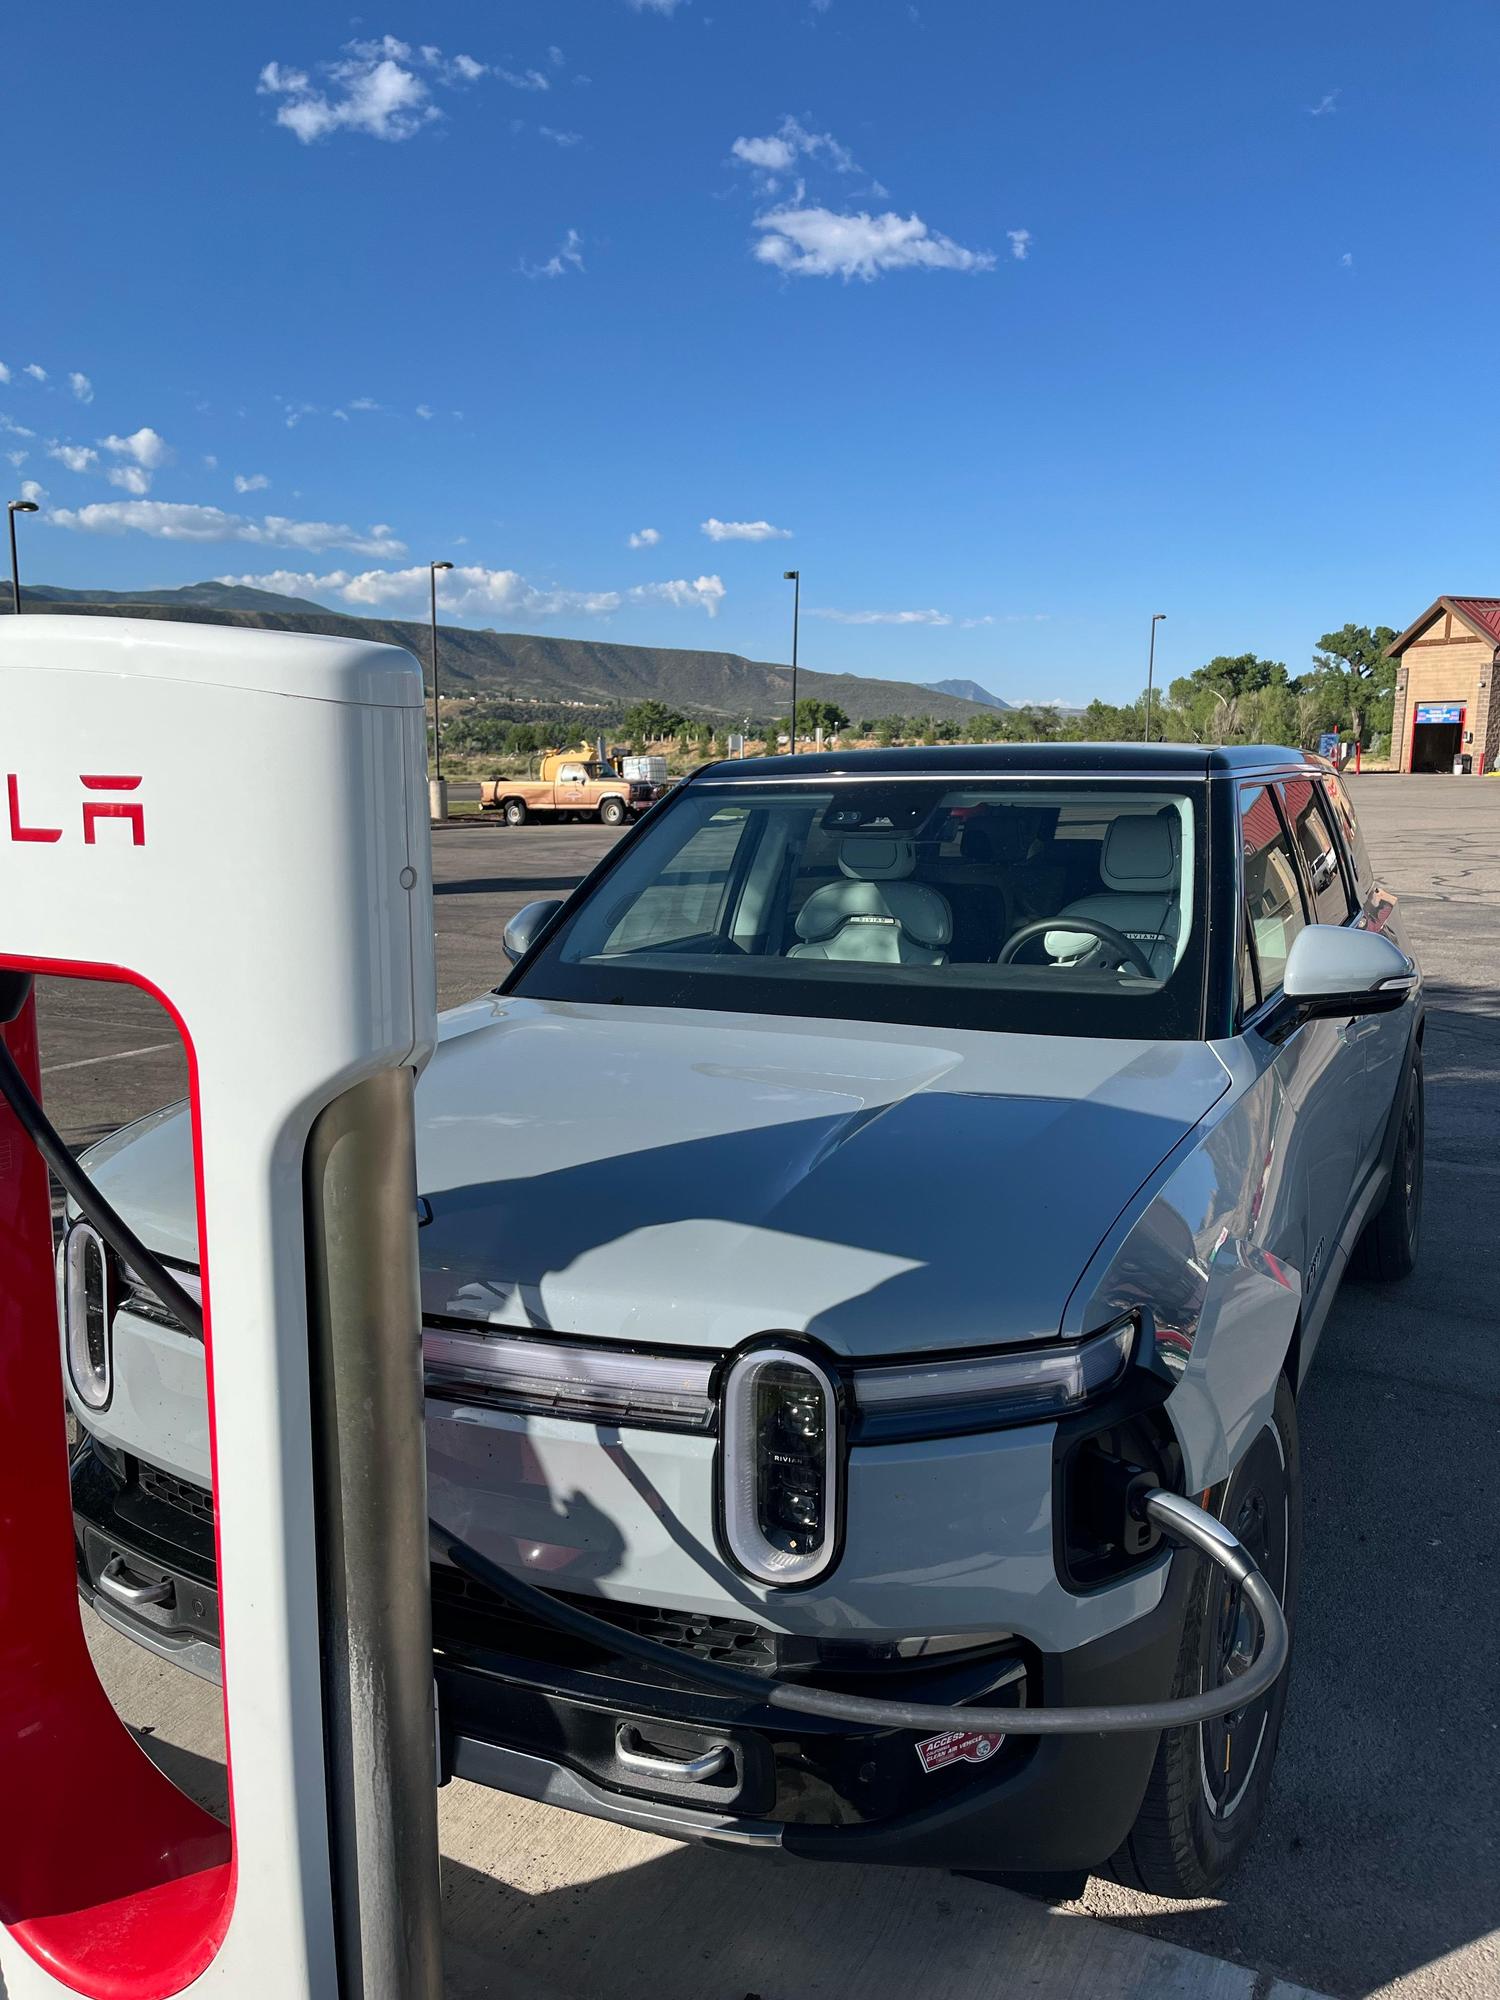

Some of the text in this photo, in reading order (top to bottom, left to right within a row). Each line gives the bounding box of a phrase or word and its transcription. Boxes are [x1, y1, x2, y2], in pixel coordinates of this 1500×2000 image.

[926, 1732, 965, 1752] ACCESS
[926, 1751, 946, 1762] CLEAN
[947, 1745, 958, 1754] AIR
[959, 1734, 983, 1749] VEHICLE
